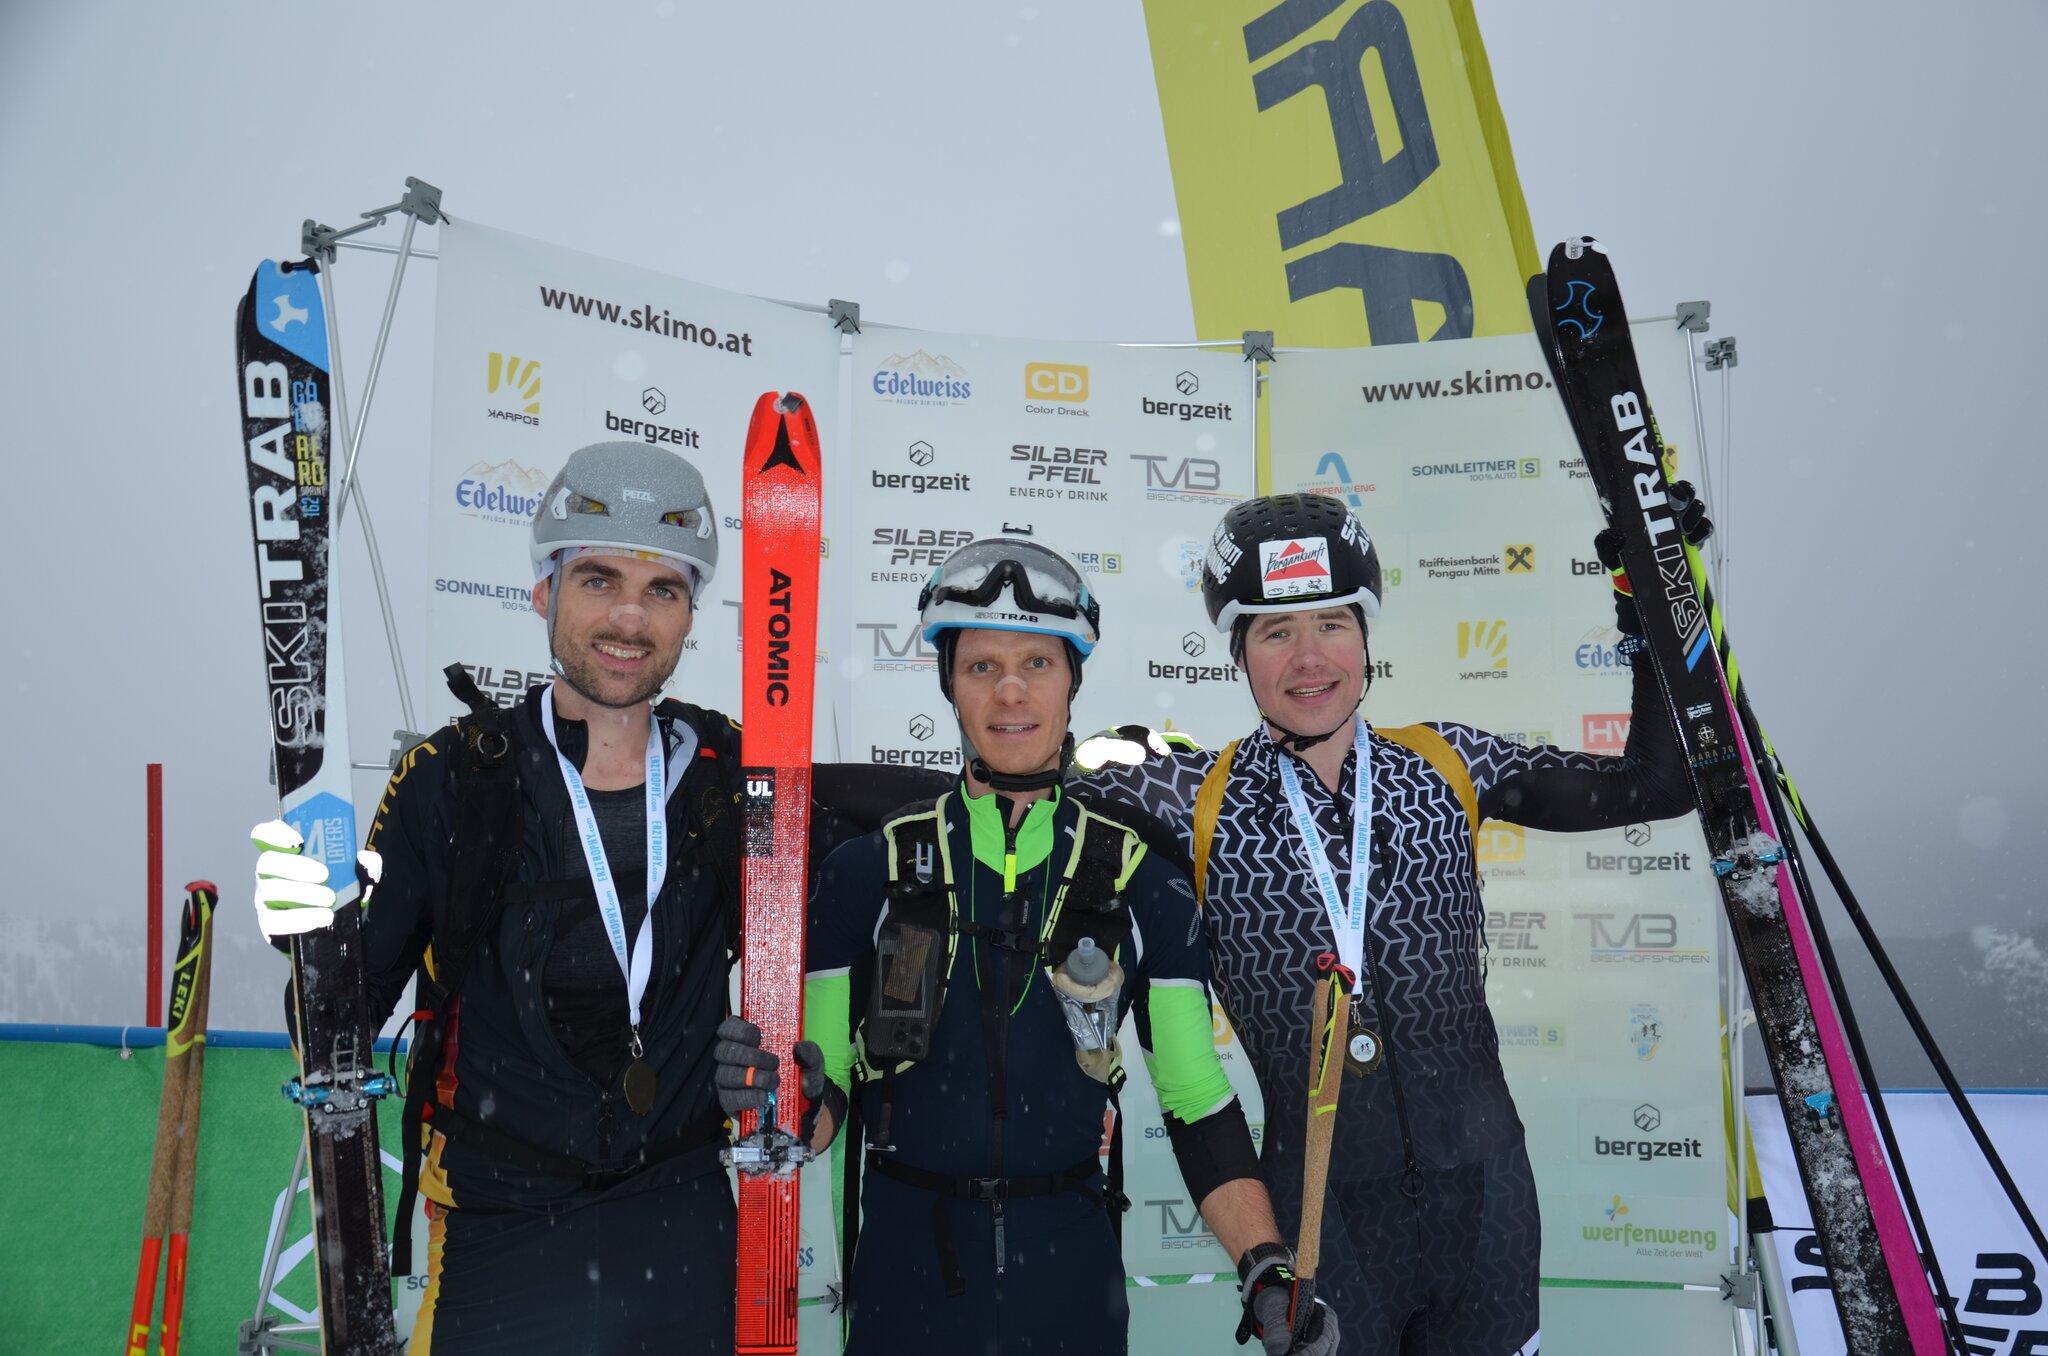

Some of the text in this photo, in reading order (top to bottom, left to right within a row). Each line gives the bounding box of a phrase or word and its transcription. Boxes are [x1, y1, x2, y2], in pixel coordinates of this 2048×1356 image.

[539, 286, 753, 357] www.skimo.at
[873, 371, 971, 399] Edelweiss
[1031, 370, 1083, 395] CD
[1362, 370, 1553, 403] www.skimo.
[1025, 405, 1089, 417] Color Drack
[1142, 397, 1232, 421] bergzeit
[605, 410, 700, 449] bergzeit
[1010, 444, 1108, 466] SILBER
[1028, 465, 1101, 485] PFEIL
[1130, 454, 1221, 491] TVB
[1412, 460, 1516, 477] SONNLEITNER
[1495, 472, 1517, 480] AUTO
[872, 470, 971, 494] bergzeit
[456, 479, 543, 518] Edelwei
[1009, 487, 1108, 502] ENERGY DRINK
[1611, 391, 1707, 640] SKITRAB
[891, 548, 948, 566] PFE
[1264, 542, 1327, 579] Bergankunft
[1419, 555, 1500, 568] Raiffeisenbank
[871, 572, 927, 582] ENERGY
[1428, 566, 1500, 580] Pongau Mitte
[435, 579, 532, 602] SONNLEITN
[766, 568, 792, 707] ATOMIC
[1149, 660, 1239, 684] bergzeit
[871, 745, 965, 768] bergzei
[1691, 745, 1734, 762] GARA 70
[747, 781, 773, 797] UL
[324, 817, 346, 864] LAYERS
[1491, 867, 1526, 877] Drack
[1586, 851, 1691, 875] bergzeit
[1572, 913, 1677, 949] TVB
[1503, 957, 1547, 967] DRINK
[1591, 954, 1710, 964] BISCHOFSHOFEN
[172, 972, 191, 1020] LEKI
[1595, 1136, 1702, 1161] bergzeit
[1582, 1223, 1717, 1251] werfenweng
[1636, 1248, 1703, 1258] Alle Zeit der Welt
